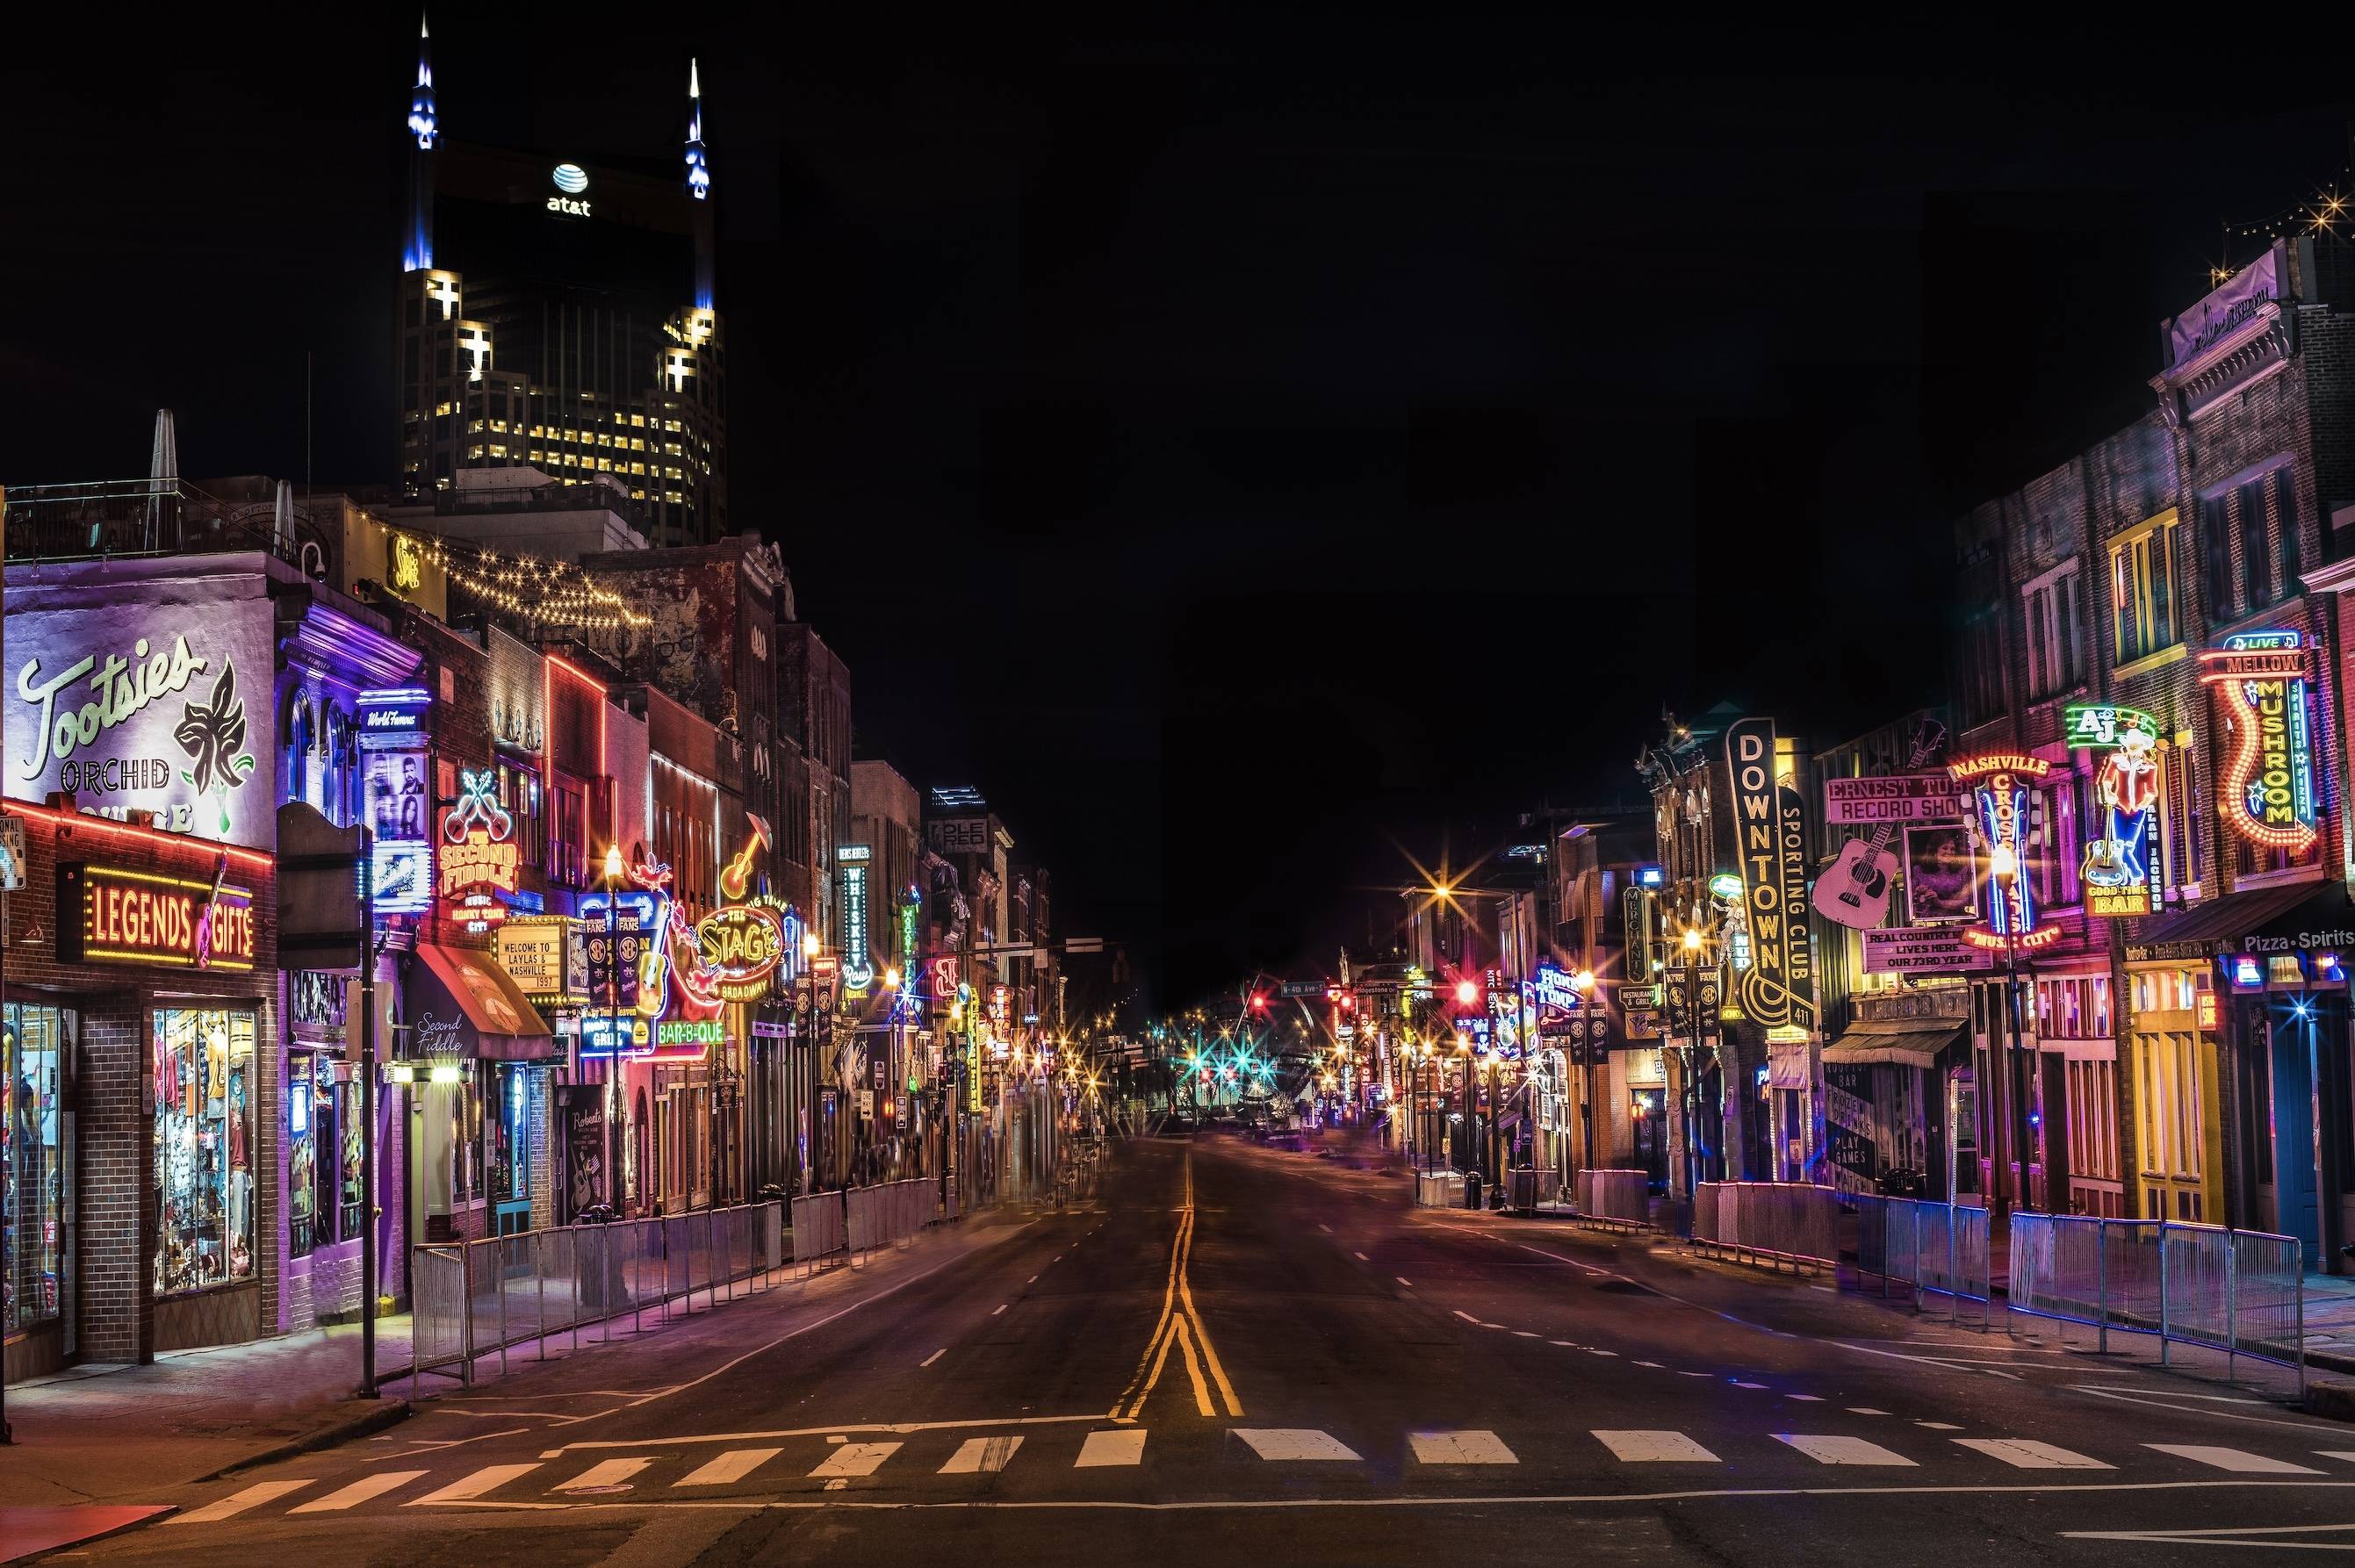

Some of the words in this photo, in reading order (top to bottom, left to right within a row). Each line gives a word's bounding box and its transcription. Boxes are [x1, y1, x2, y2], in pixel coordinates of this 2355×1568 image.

[547, 197, 591, 217] at&t
[2247, 637, 2279, 650] LIVE
[2226, 656, 2299, 673] MELLOW
[16, 635, 208, 780] Tootsies
[2291, 684, 2302, 749] SPIRITS
[2257, 680, 2294, 823] MUSHROOM
[60, 758, 170, 796] ORCHID
[1953, 756, 2049, 779] NASHVILLE
[1830, 780, 1911, 799] ERNEST
[2297, 767, 2307, 815] PIZZA
[1841, 800, 1913, 819] RECORD
[943, 822, 984, 835] OLE
[2147, 804, 2157, 841] ALAN
[0, 834, 19, 847] SING
[944, 834, 984, 845] RED
[439, 843, 517, 870] SECOND
[1739, 734, 1780, 970] DOWNTOWN
[1782, 807, 1806, 914] SPORTING
[443, 863, 515, 895] FIDDLE
[2150, 847, 2163, 911] JACKSON
[763, 895, 789, 913] TIME
[2094, 895, 2145, 914] BAR
[92, 886, 191, 949] LEGENDS
[211, 905, 250, 957] GIFTS
[618, 922, 640, 931] FANS
[847, 867, 861, 967] WHISKEY
[587, 923, 607, 933] FANS
[1626, 891, 1641, 977] MERCHANTS
[1869, 933, 1898, 943] REAL
[1899, 931, 1951, 942] COUNTRY
[504, 943, 537, 953] WELCOME
[540, 943, 550, 953] TO
[698, 918, 780, 966] STAGE
[1897, 945, 1929, 953] LIVES
[1932, 944, 1959, 953] HERE
[2244, 936, 2289, 953] Pizza
[2299, 929, 2355, 949] Spirits
[508, 954, 537, 964] LAYLAS
[1790, 924, 1809, 980] CLUB
[1888, 958, 1911, 967] OUR
[1913, 957, 1941, 966] 73RD
[1942, 955, 1973, 964] YEAR
[509, 966, 546, 975] NASHVILLE
[1540, 967, 1580, 991] HONK
[537, 976, 552, 987] 1997
[722, 979, 768, 998] BROADWAY
[1623, 990, 1654, 999] RESTAURANT
[417, 1011, 463, 1032] Second
[1794, 1007, 1809, 1025] 411
[416, 1031, 463, 1054] Fiddle
[659, 1022, 724, 1044] BAR-B-QUE
[1391, 1037, 1401, 1090] BOOTS
[1839, 1075, 1857, 1088] BAR
[1834, 1136, 1859, 1149] PLAY
[1835, 1151, 1866, 1164] GAMES
